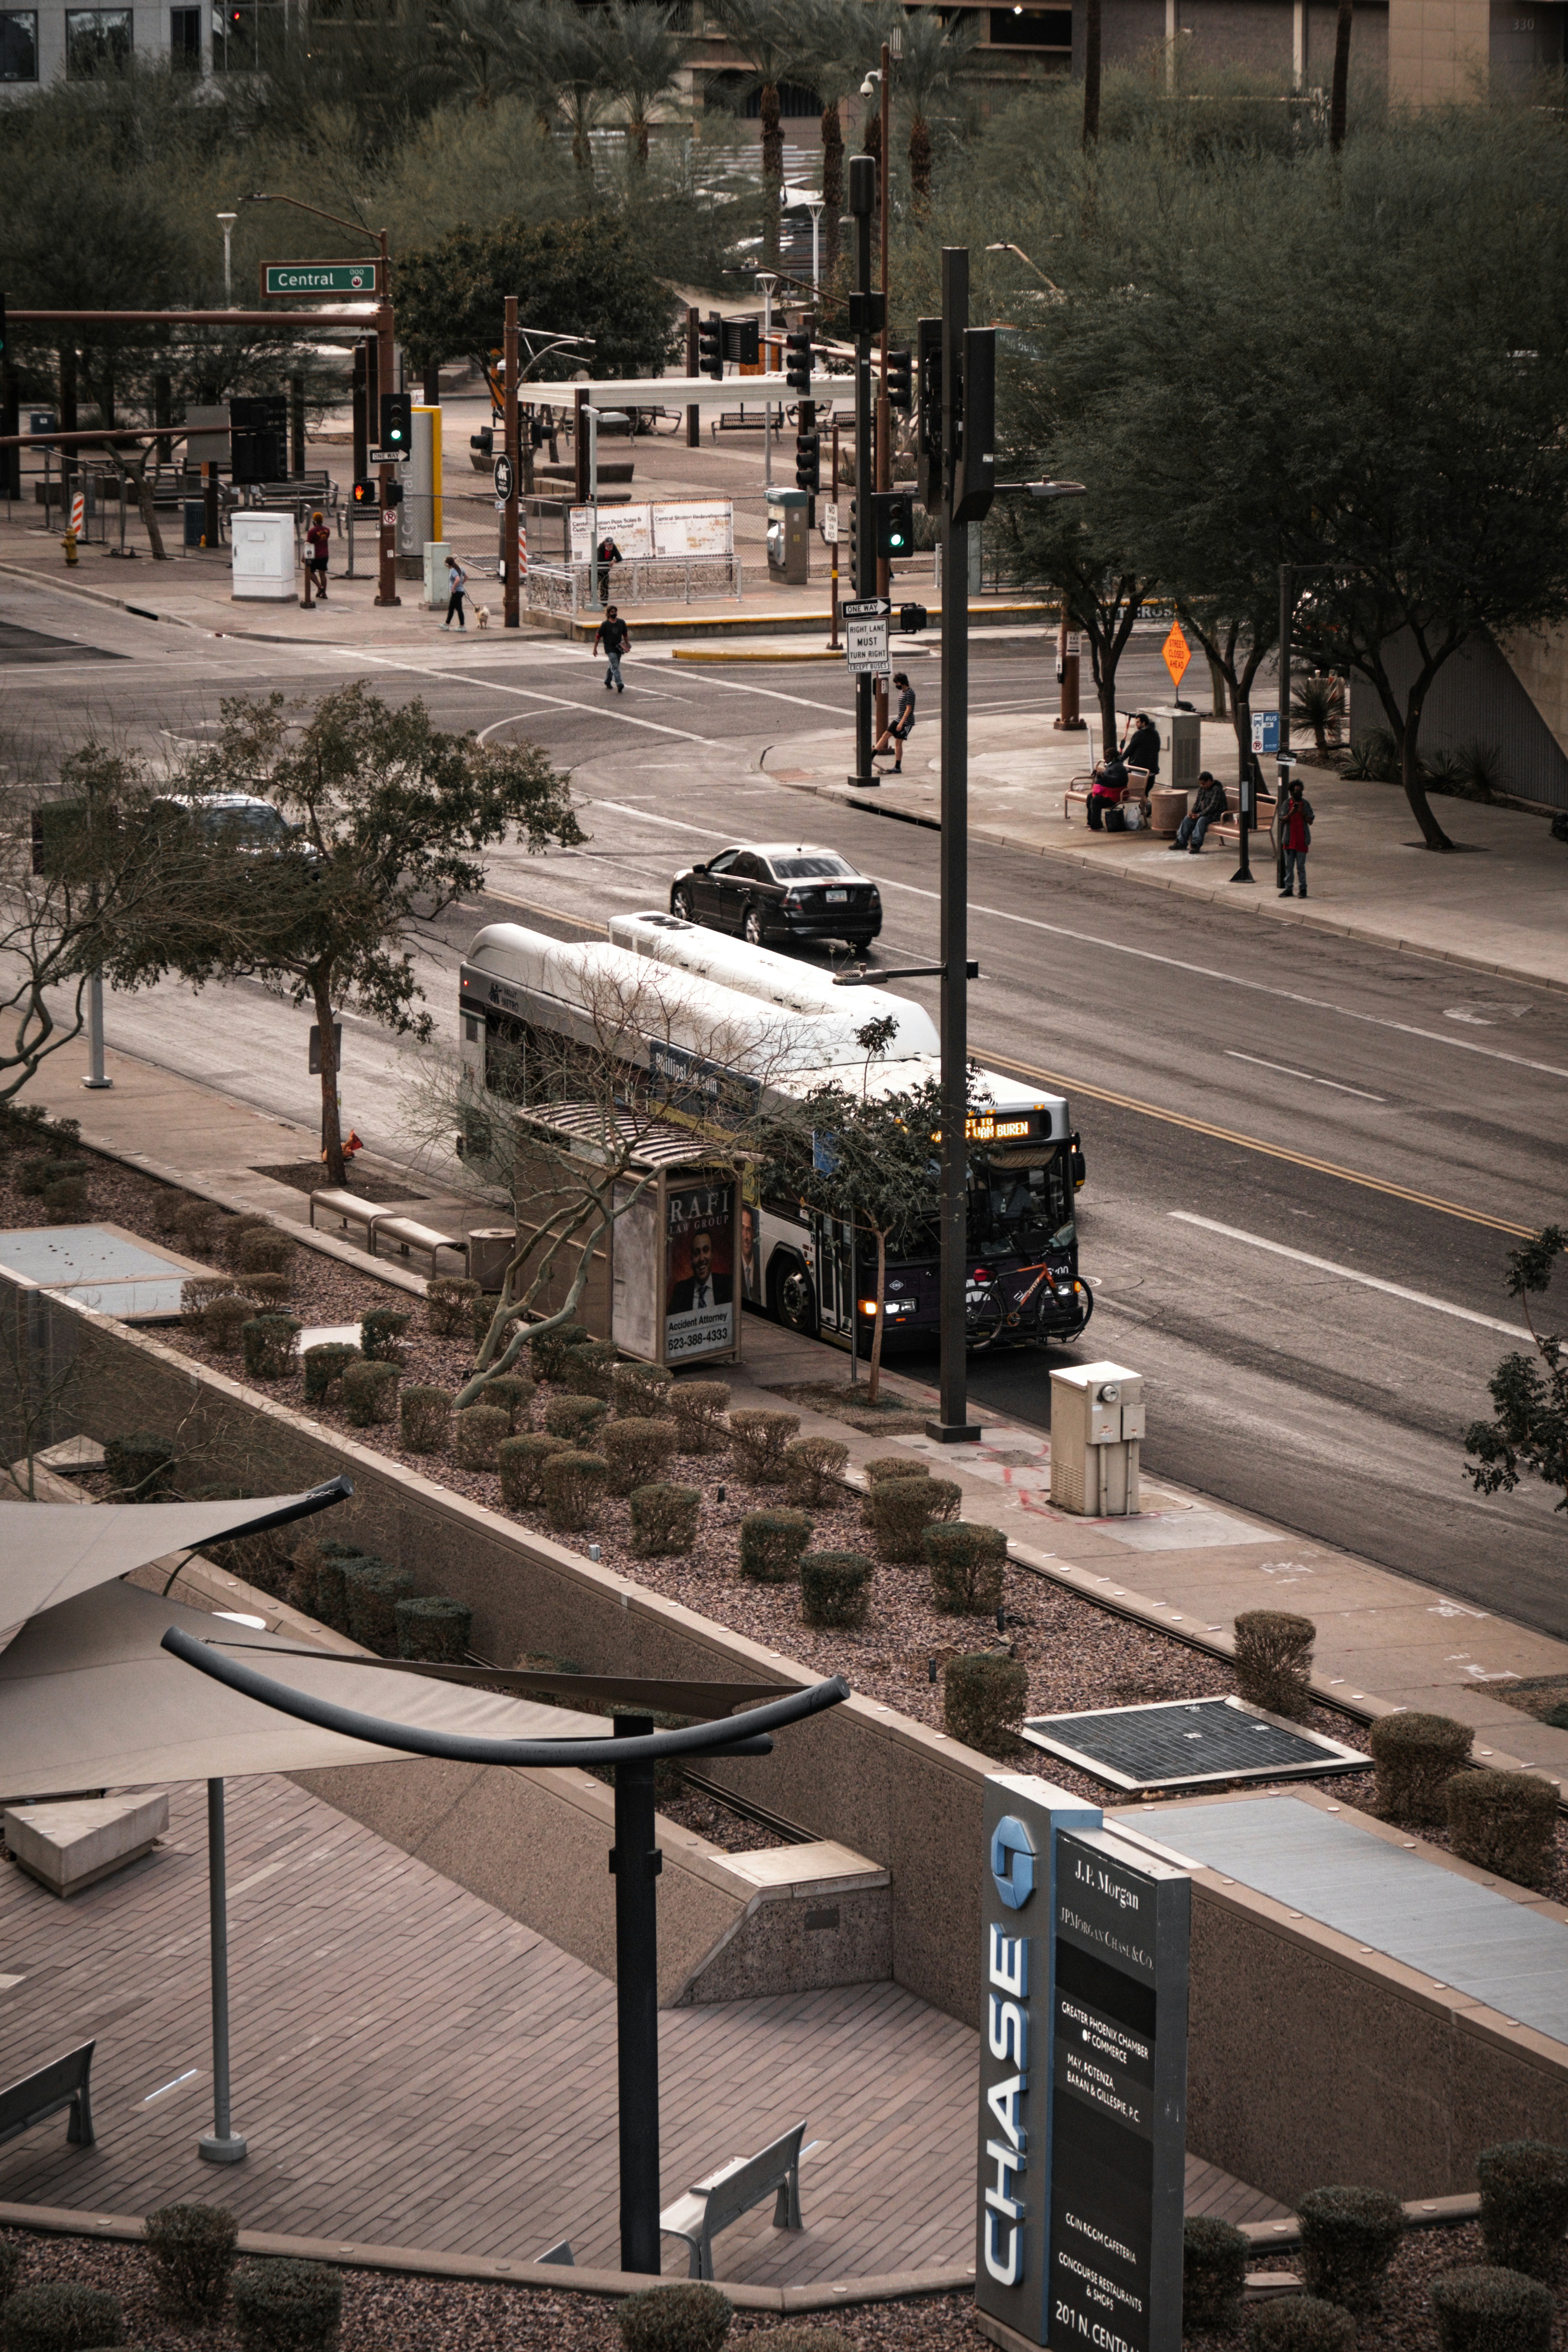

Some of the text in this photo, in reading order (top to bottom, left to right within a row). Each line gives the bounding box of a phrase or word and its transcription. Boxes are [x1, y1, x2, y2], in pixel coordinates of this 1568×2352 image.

[1513, 19, 1534, 31] 330
[278, 273, 334, 286] Central
[401, 475, 412, 534] Central
[828, 506, 835, 514] NO
[858, 637, 877, 646] MUST
[1169, 639, 1184, 649] STREET
[1169, 649, 1185, 659] CLOSED
[1169, 660, 1184, 669] AHEAD
[502, 997, 519, 1012] METRO
[996, 1122, 1028, 1137] BUREN
[670, 1190, 729, 1223] RAFI
[670, 1215, 729, 1234] LAW GROUP
[668, 1313, 727, 1331] Accident Attorney
[668, 1328, 727, 1350] 623-388-4333
[1075, 1860, 1138, 1910] J.P. Morgan
[1062, 2001, 1149, 2060] GREATER PHOENIX CHAMBER
[1092, 2034, 1127, 2064] COMMERCE
[1068, 2053, 1115, 2092] MAY, POTENZA,
[985, 1923, 1028, 2287] CHASE
[1067, 2070, 1140, 2123] BARAN & GILLESPIE, P.C.
[1066, 2212, 1136, 2265] COIN ROOM CAFETERIA
[1059, 2252, 1142, 2312] CONCOURSE RESTAURANTS
[1086, 2284, 1114, 2311] & SHOPS
[1056, 2300, 1139, 2352] 201 N. CENTR
